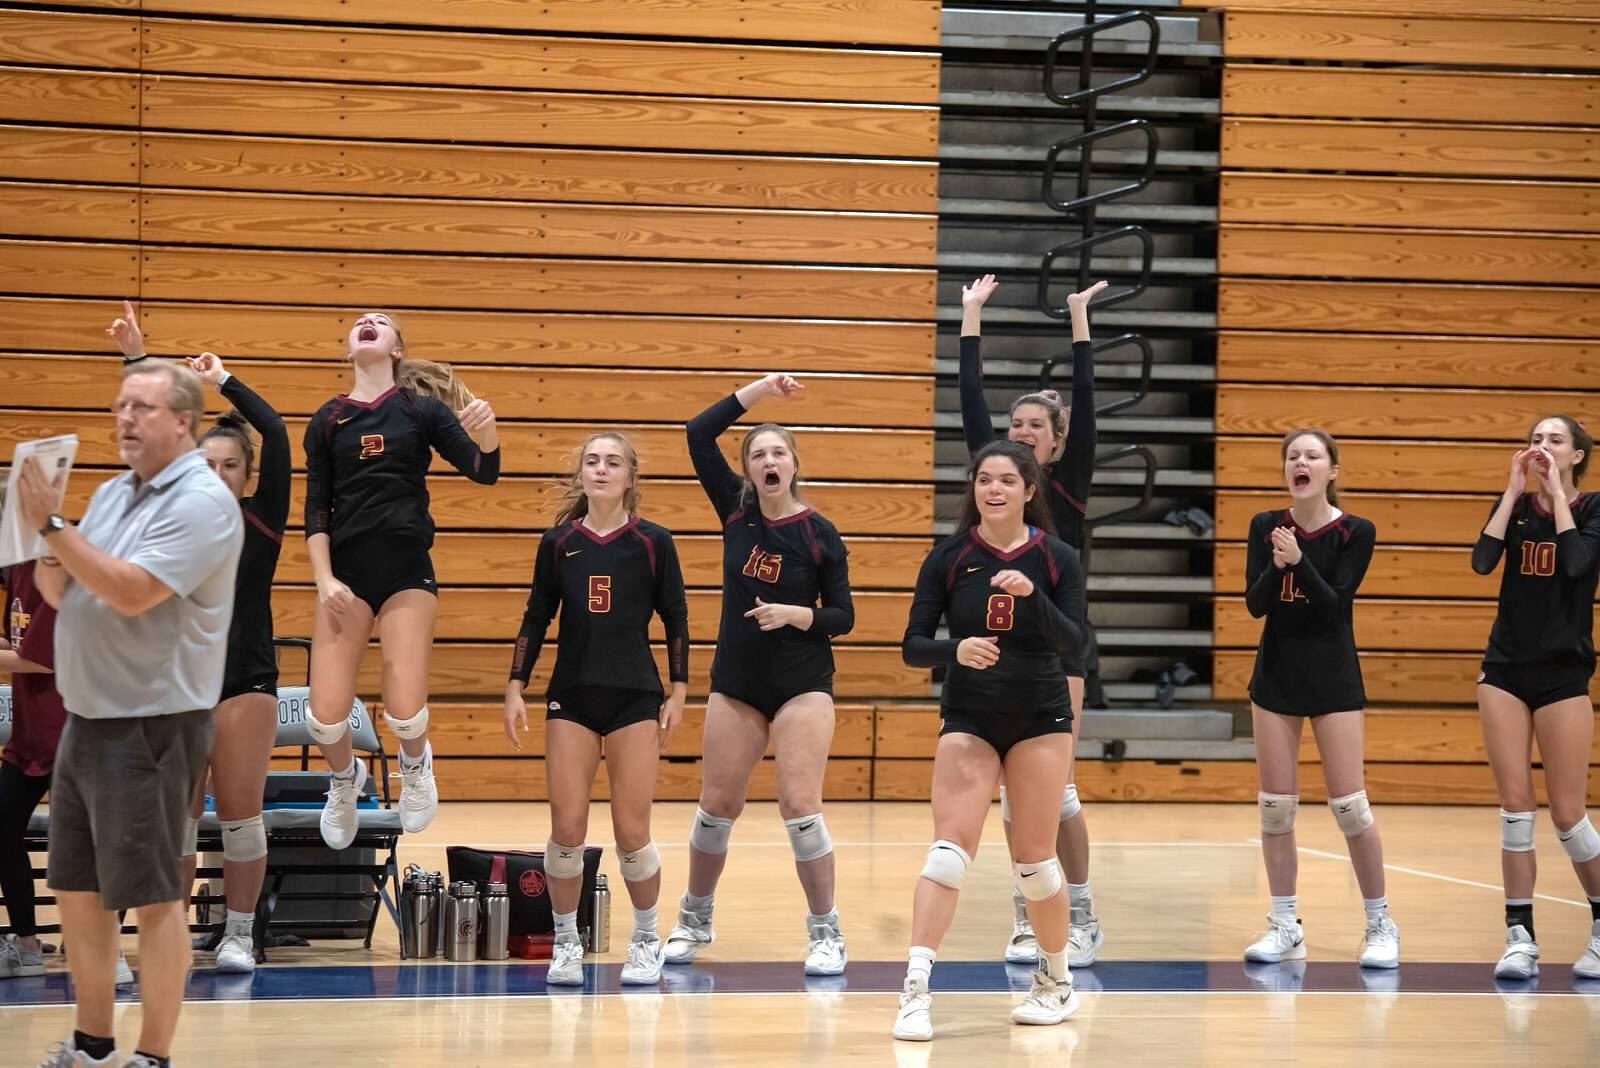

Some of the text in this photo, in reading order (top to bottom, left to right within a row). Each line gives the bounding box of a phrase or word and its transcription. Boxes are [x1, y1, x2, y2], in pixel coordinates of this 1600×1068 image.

[360, 434, 385, 460] 2
[742, 544, 783, 583] 15
[1520, 540, 1557, 576] 10
[588, 575, 612, 613] 5
[1280, 571, 1309, 603] 1
[986, 594, 1015, 631] 8
